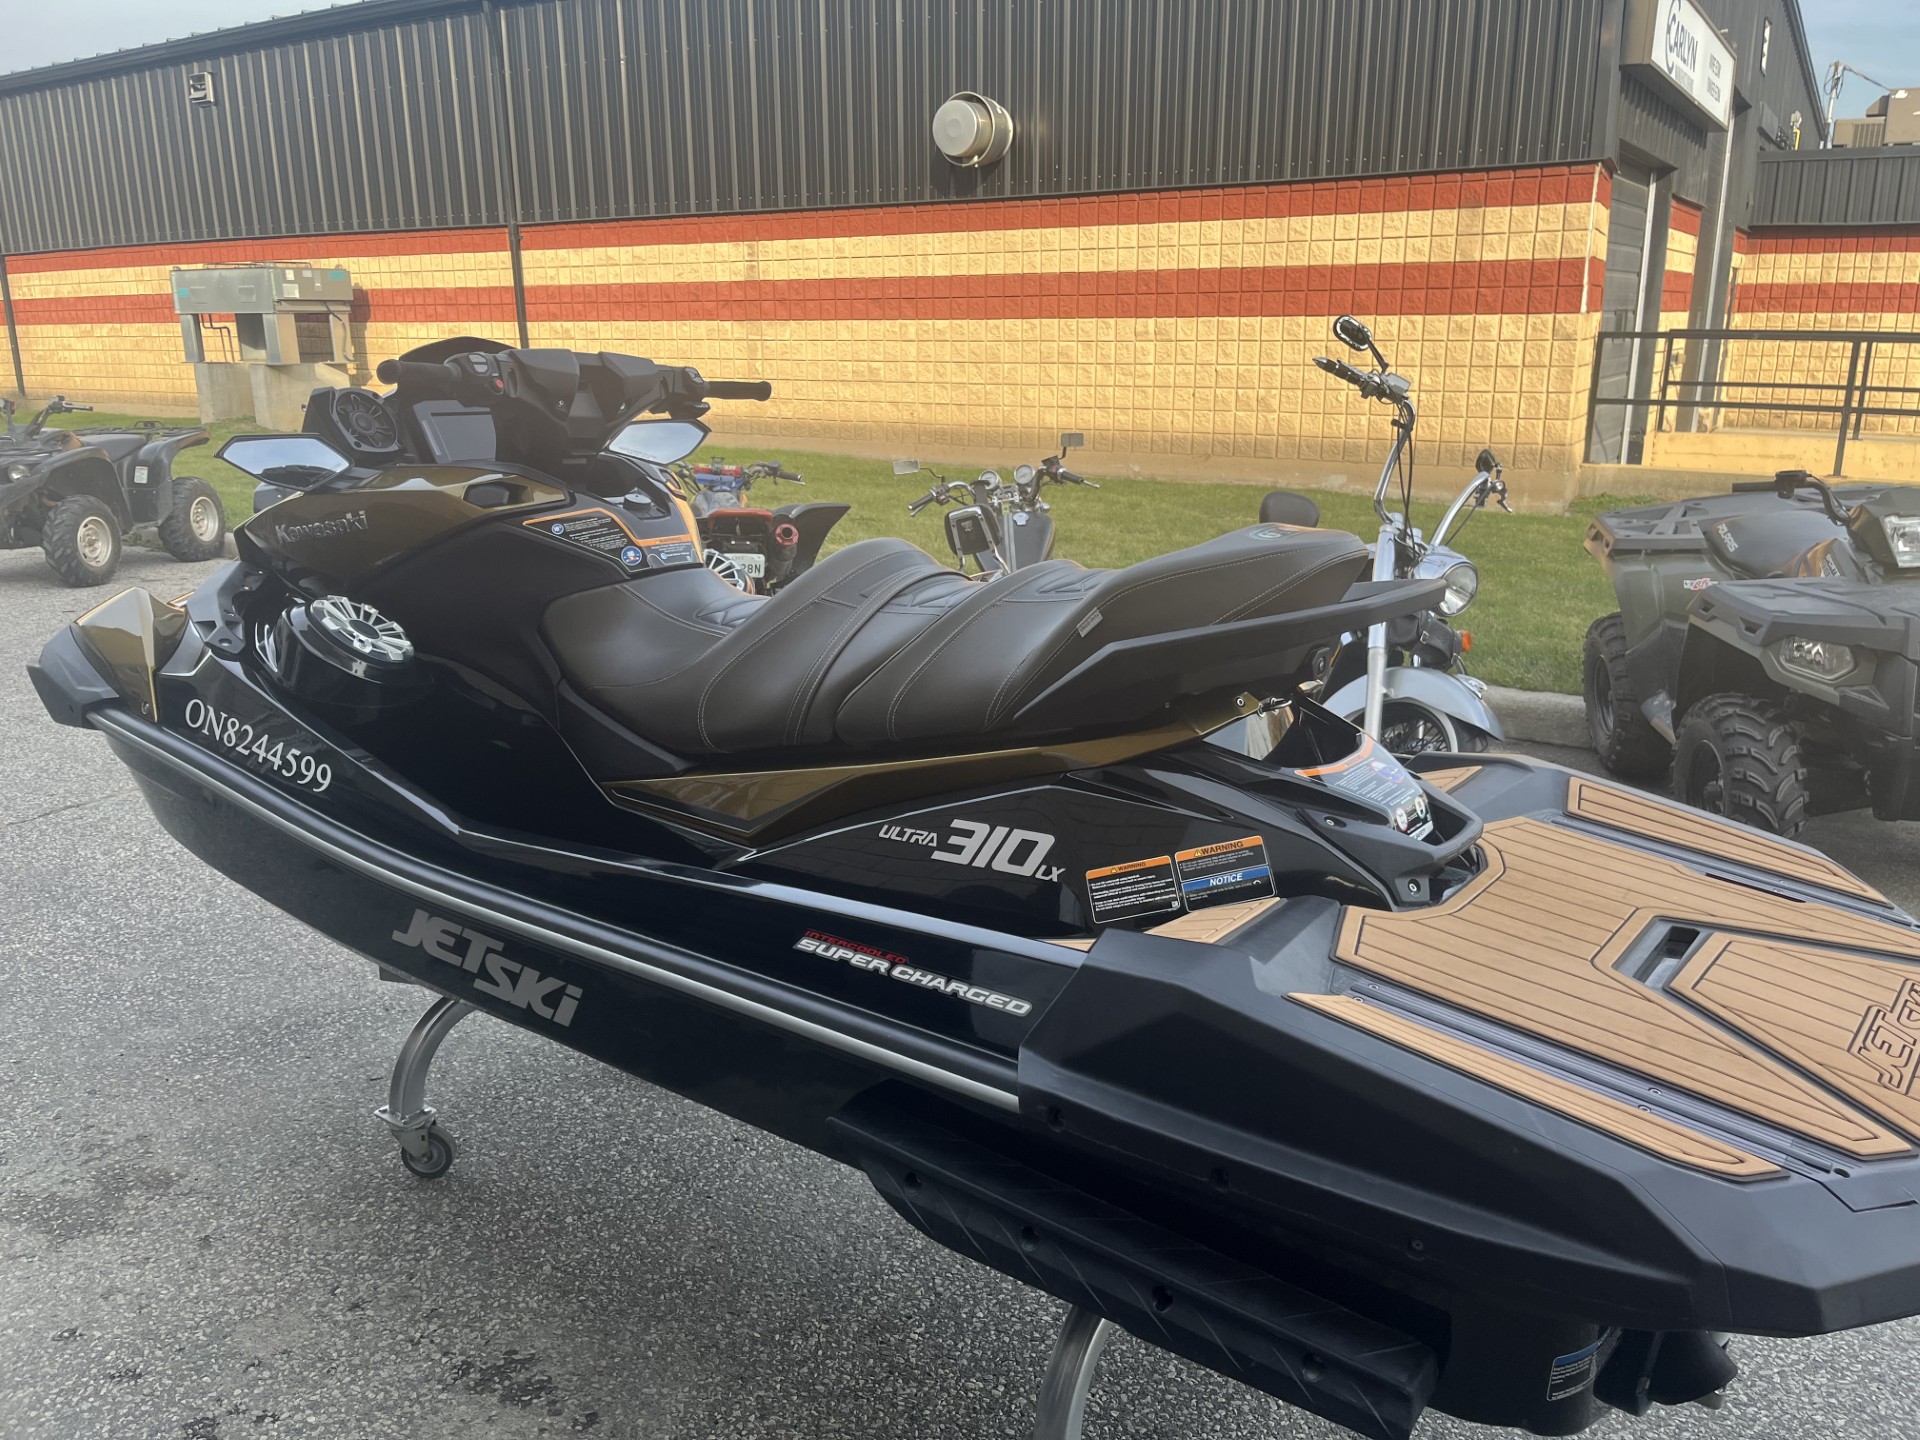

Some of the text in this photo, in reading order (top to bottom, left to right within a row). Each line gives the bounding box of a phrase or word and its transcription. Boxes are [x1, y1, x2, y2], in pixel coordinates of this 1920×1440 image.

[274, 510, 369, 544] Kawasaki
[1716, 522, 1739, 552] POLARIS
[185, 698, 332, 792] ON8244599
[878, 818, 1066, 882] ULTRA 310 LX
[1202, 841, 1244, 855] WARNING
[1118, 862, 1146, 871] WARNING
[1209, 872, 1243, 887] NOTICE
[796, 937, 1033, 1016] SUPER CHARGED
